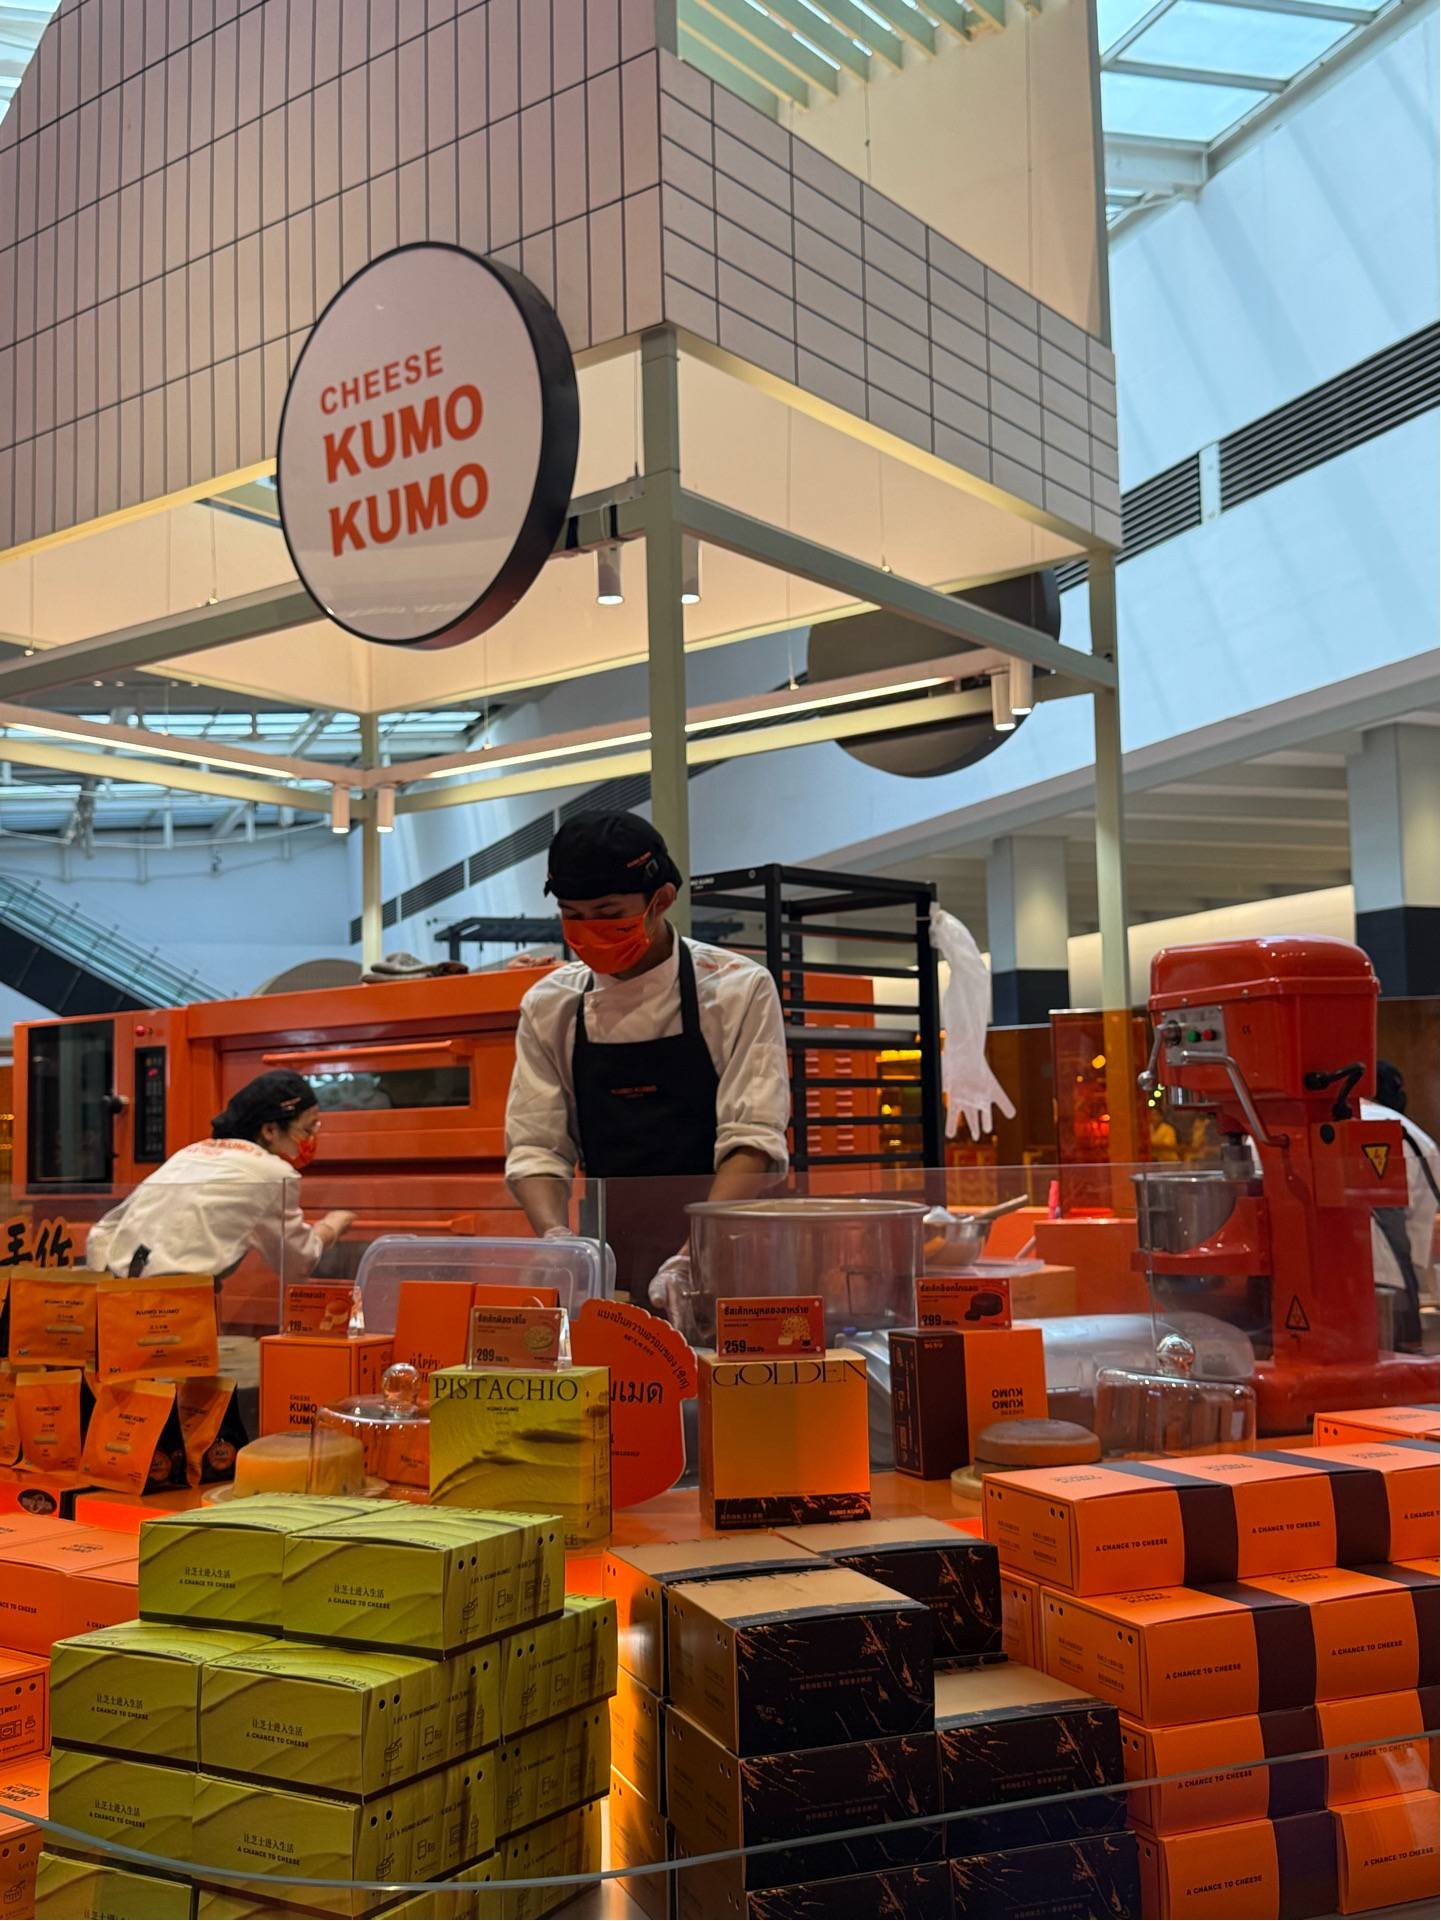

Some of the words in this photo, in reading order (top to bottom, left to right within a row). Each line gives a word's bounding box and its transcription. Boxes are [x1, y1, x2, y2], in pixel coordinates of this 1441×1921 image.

[320, 345, 444, 416] CHEESE
[323, 384, 483, 484] KUMO
[328, 463, 489, 558] KUMO
[725, 1340, 746, 1354] 259
[712, 1359, 866, 1387] GOLDEN
[433, 1377, 579, 1401] PISTACHIO
[991, 1388, 1024, 1399] KUMO
[289, 1403, 318, 1413] KUMO
[991, 1400, 1024, 1410] KUMO
[1410, 1510, 1433, 1519] CHANCE
[1258, 1525, 1285, 1534] CHANCE
[1296, 1521, 1322, 1530] CHEESE
[1102, 1542, 1130, 1552] CHANCE
[1142, 1538, 1168, 1547] CHEESE
[185, 1579, 207, 1588] CHANCE
[216, 1582, 236, 1590] CHEESE
[18, 1605, 37, 1614] CHEESE
[333, 1596, 358, 1606] CHANCE
[368, 1600, 392, 1609] CHEESE
[1337, 1645, 1365, 1656] CHANCE
[1377, 1641, 1404, 1651] CHEESE
[1172, 1668, 1202, 1679] CHANCE
[1215, 1663, 1242, 1674] CHEESE
[96, 1706, 118, 1716] CHANCE
[128, 1711, 150, 1720] CHEESE
[251, 1732, 276, 1743] CHANCE
[286, 1738, 310, 1749] CHEESE
[1350, 1749, 1377, 1760] CHANCE
[1389, 1743, 1414, 1754] CHEESE
[1184, 1776, 1213, 1788] CHANCE
[1226, 1770, 1254, 1782] CHEESE
[94, 1811, 116, 1823] CHANCE
[125, 1818, 146, 1829] CHEESE
[243, 1847, 267, 1859] CHANCE
[278, 1854, 301, 1866] CHEESE
[1370, 1853, 1398, 1865] CHANCE
[1410, 1847, 1436, 1858] CHEESE
[1192, 1882, 1222, 1894] CHANCE
[1235, 1875, 1262, 1887] CHEESE
